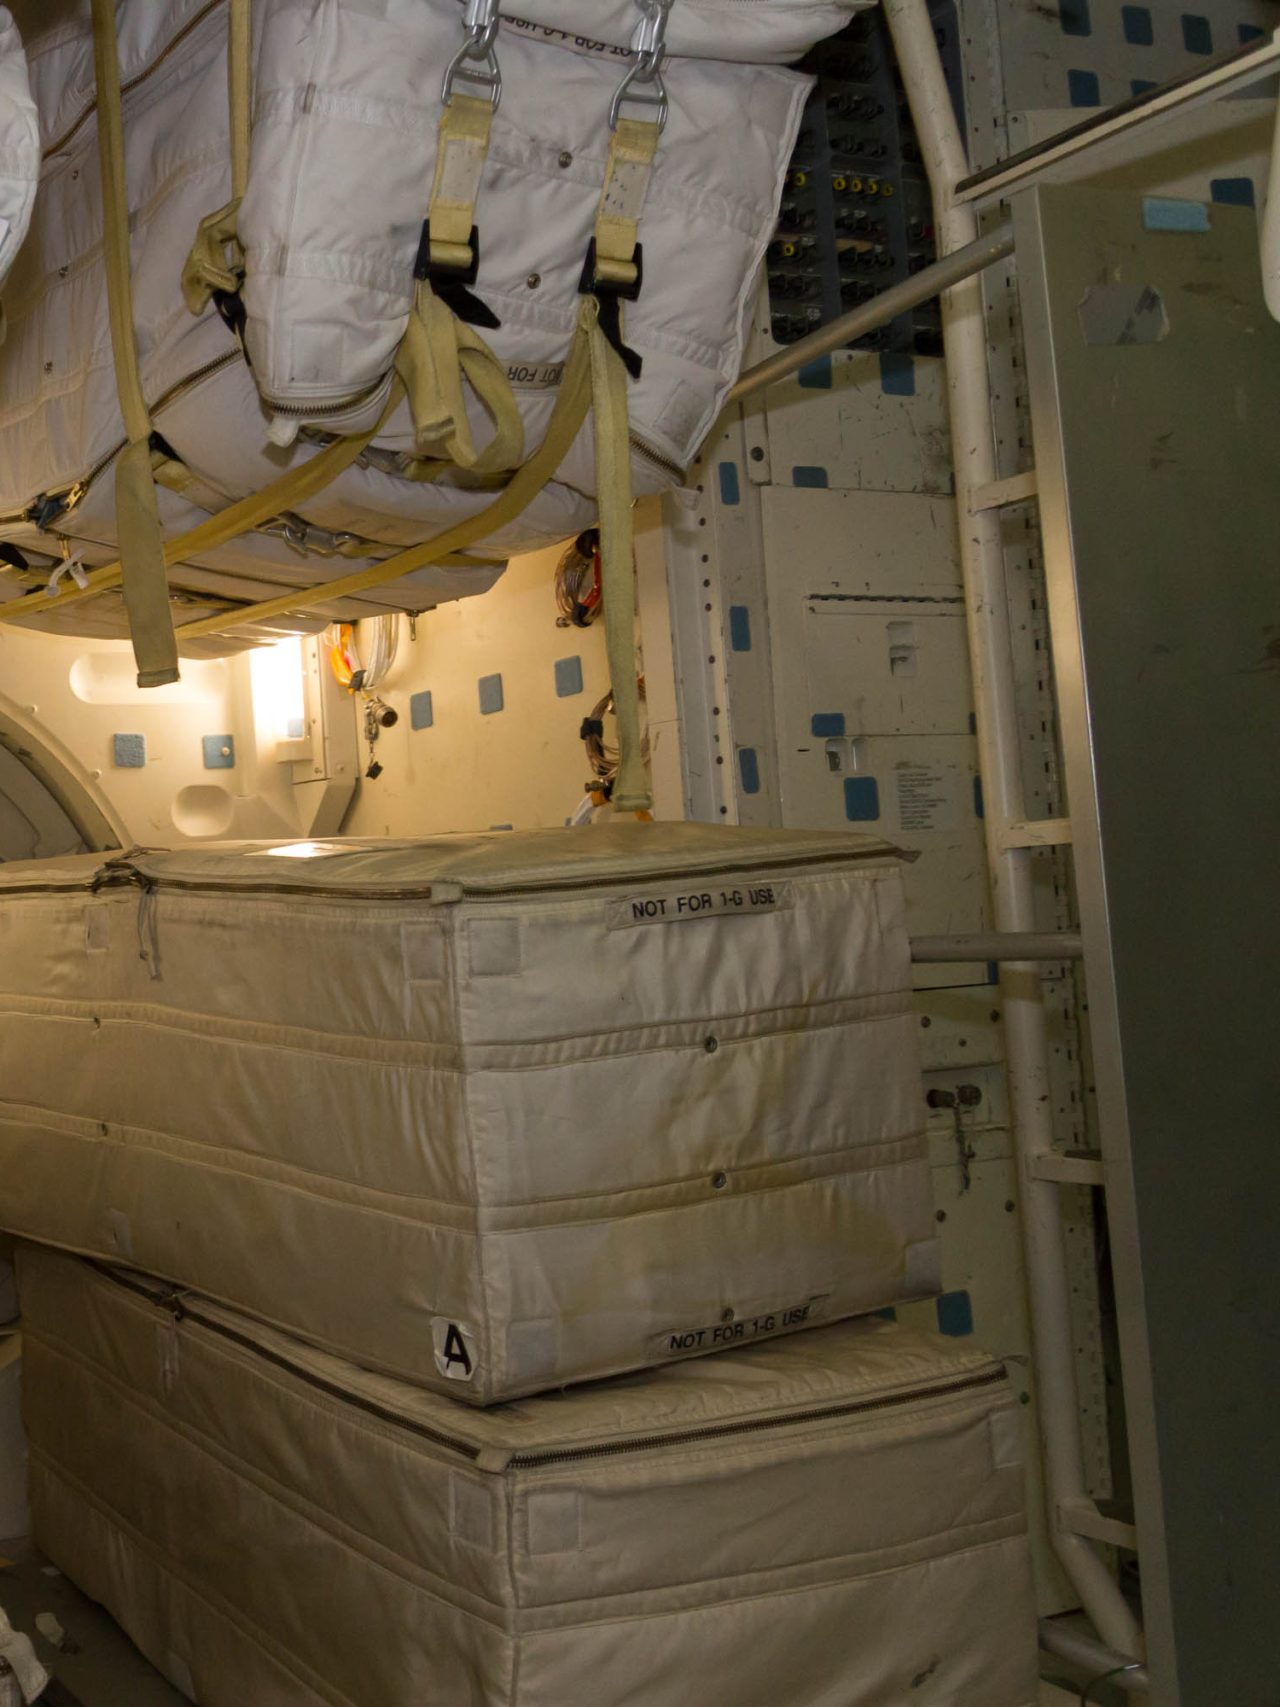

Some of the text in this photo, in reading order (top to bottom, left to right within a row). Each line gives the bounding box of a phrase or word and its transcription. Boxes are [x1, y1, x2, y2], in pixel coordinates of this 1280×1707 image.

[507, 366, 538, 383] FOR
[631, 888, 775, 918] NOT FOR 1-G USE
[669, 1304, 811, 1349] NOT FOR 1-G USE
[444, 1323, 473, 1376] A
